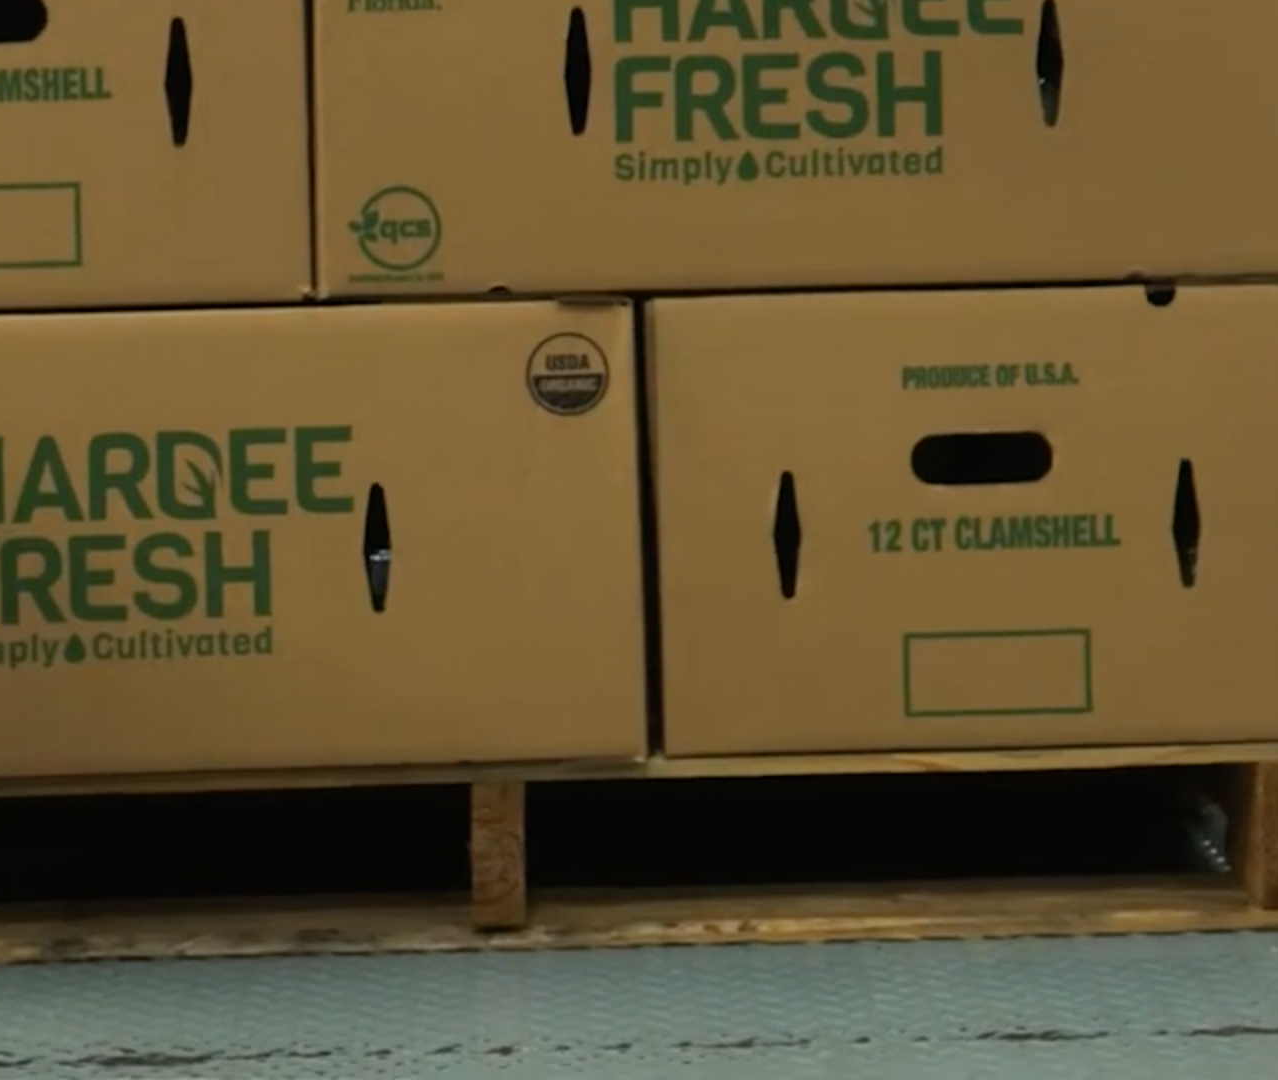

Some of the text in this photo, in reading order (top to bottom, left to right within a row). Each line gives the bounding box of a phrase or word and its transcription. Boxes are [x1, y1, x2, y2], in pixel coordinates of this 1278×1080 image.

[614, 50, 942, 143] FRESH
[615, 146, 943, 185] Simply Cultivated
[380, 219, 431, 245] qcs
[545, 354, 590, 372] USDA
[902, 363, 1078, 388] PRODUCE OF U.S.A.
[869, 514, 1120, 552] 12 CT CLAMSHELL
[92, 627, 273, 660] Cultivated
